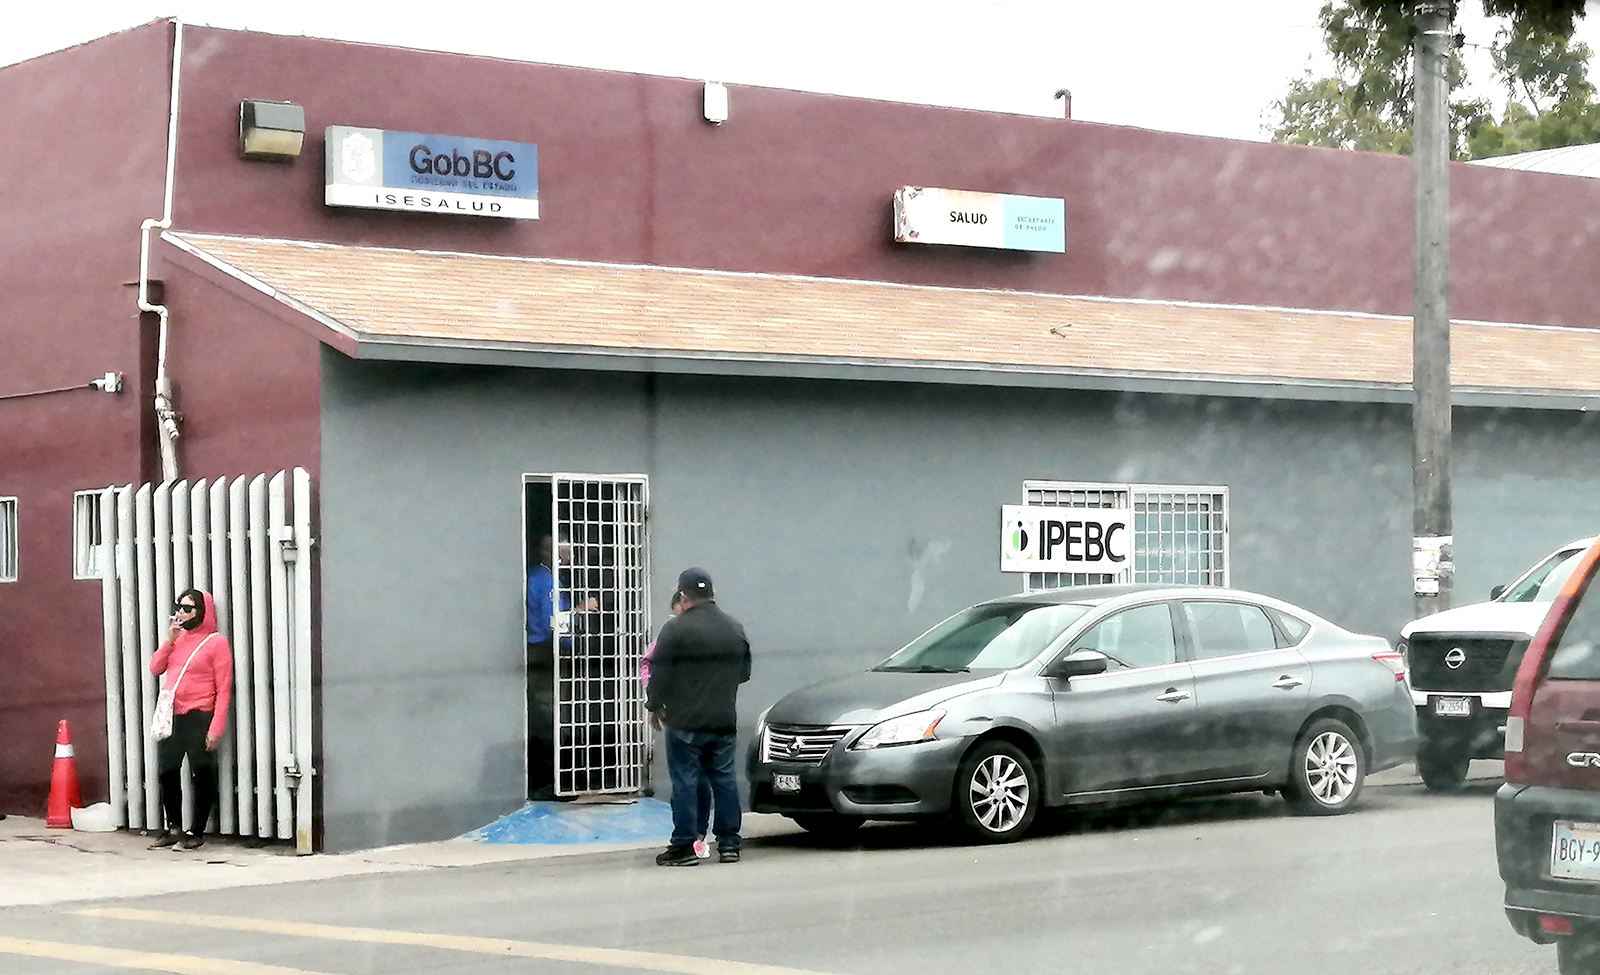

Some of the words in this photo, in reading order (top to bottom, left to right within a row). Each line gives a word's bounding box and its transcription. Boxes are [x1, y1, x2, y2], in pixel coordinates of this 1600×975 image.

[409, 144, 516, 181] GobBC
[375, 193, 502, 212] ISESALUD
[949, 210, 988, 225] SALUD
[1039, 519, 1126, 563] IPEBC
